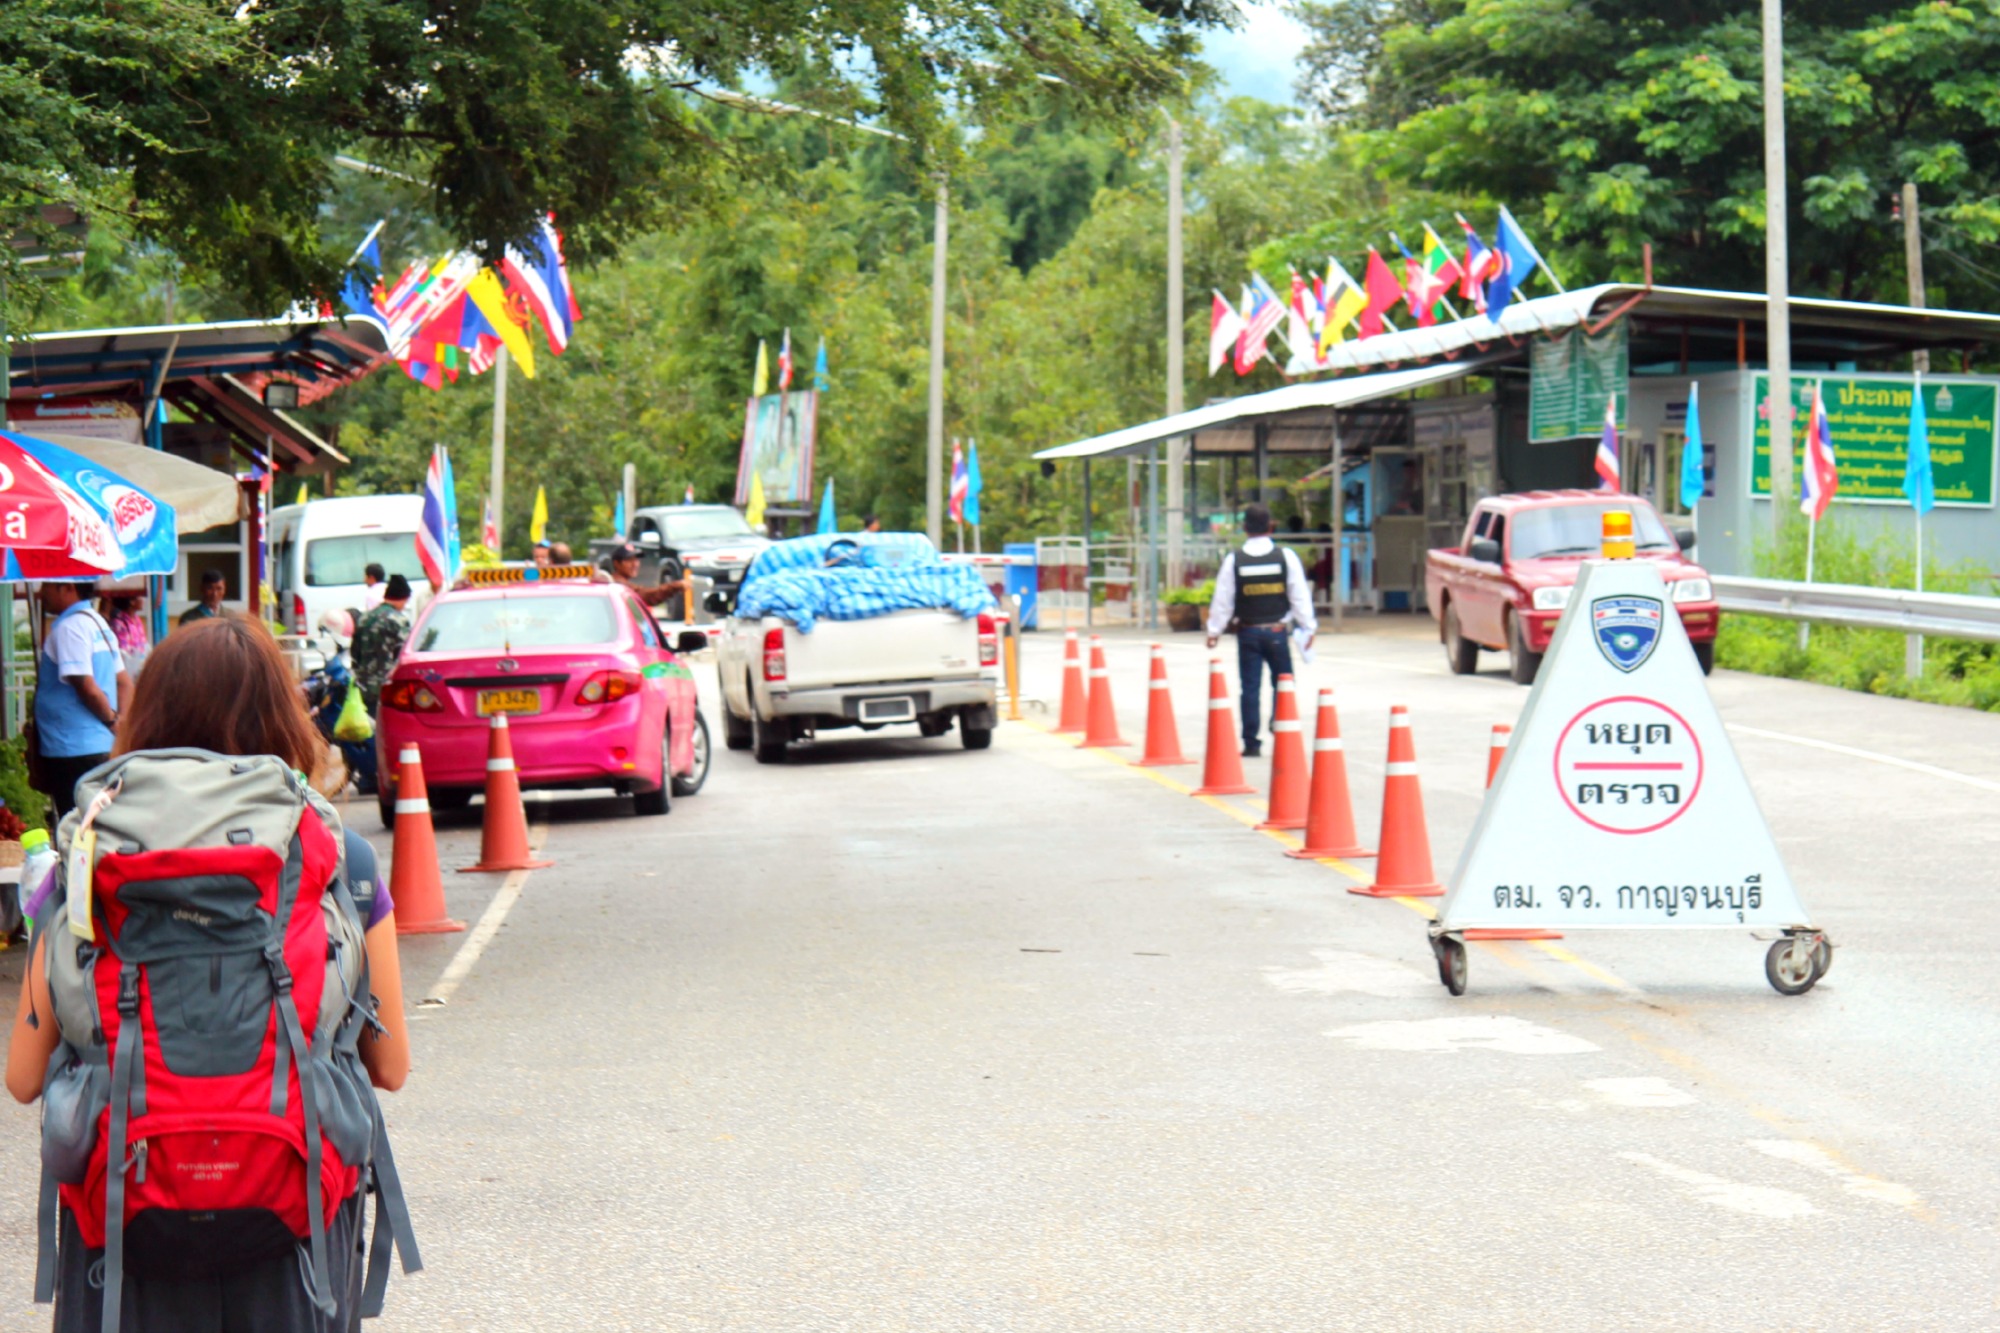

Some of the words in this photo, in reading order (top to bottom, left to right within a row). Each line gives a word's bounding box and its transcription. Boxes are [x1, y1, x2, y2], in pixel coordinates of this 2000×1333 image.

[1585, 723, 1672, 755] หยุด
[1577, 783, 1681, 805] ตรวจ
[1494, 884, 1542, 909] ตม.
[1557, 884, 1602, 909] จว.
[1617, 873, 1763, 923] กาญจนบุรี
